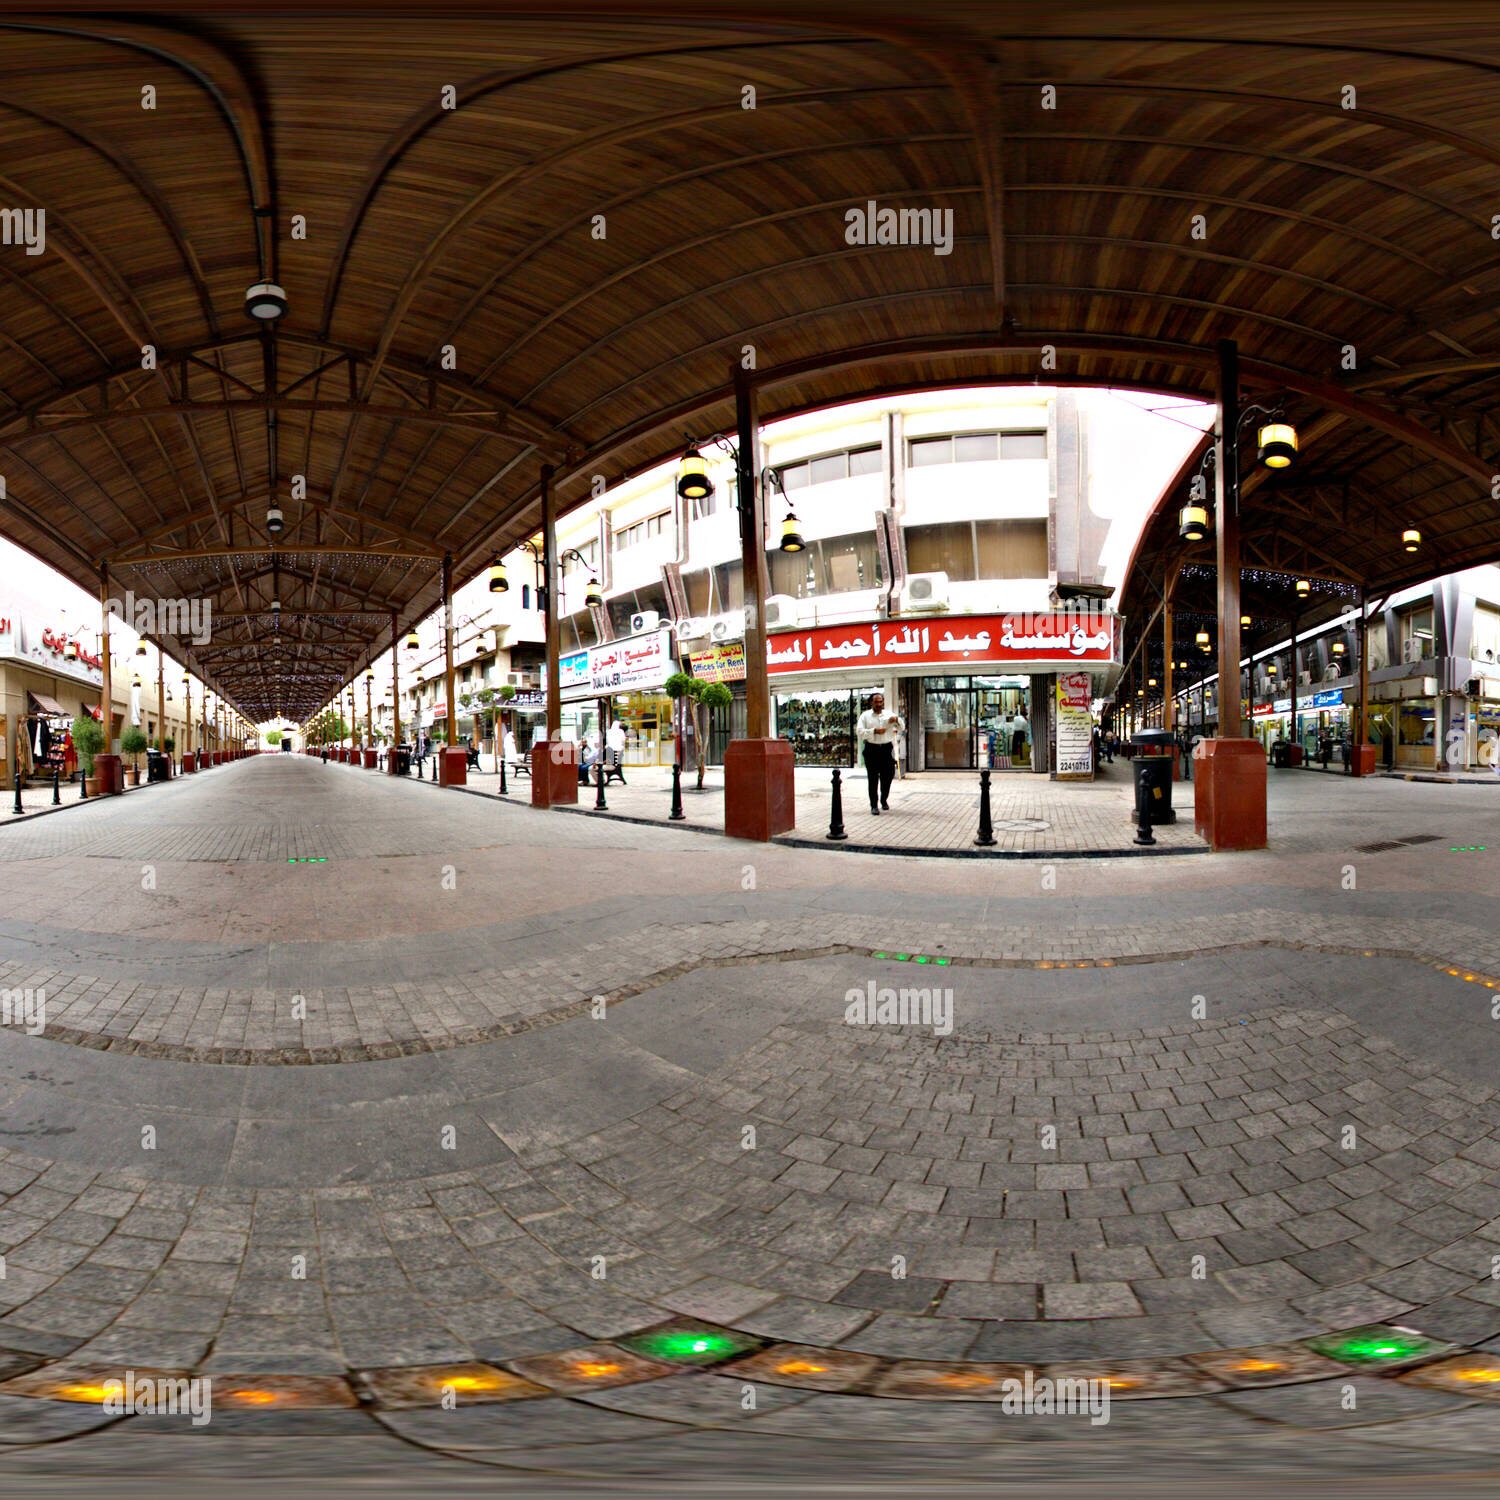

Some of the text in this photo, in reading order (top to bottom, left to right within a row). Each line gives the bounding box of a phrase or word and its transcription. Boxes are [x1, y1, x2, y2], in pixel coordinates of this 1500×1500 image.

[625, 643, 660, 666] دعيج
[767, 622, 1111, 664] مؤسسة عبد الله أحمد المسل
[692, 657, 744, 672] Offices for Rent
